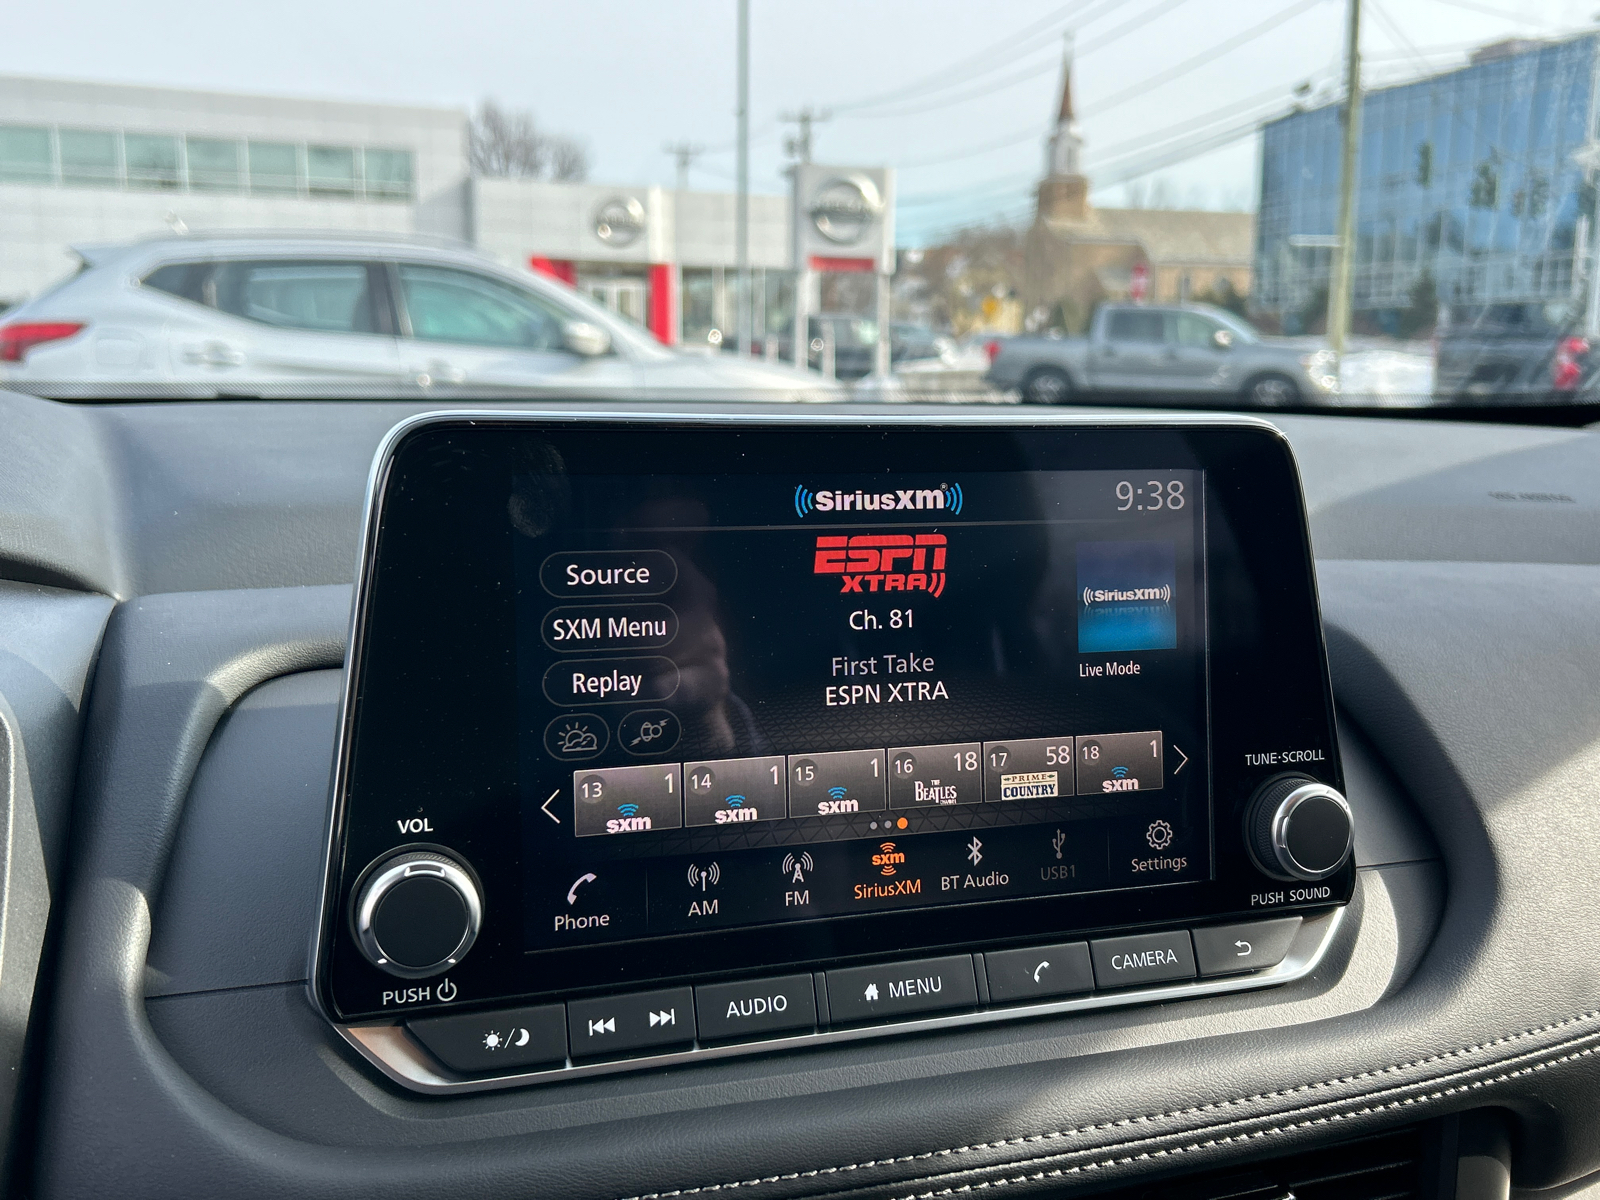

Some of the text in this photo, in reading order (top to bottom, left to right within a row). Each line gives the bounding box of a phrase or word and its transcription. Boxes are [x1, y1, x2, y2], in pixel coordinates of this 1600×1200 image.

[1115, 480, 1186, 511] 9:38
[813, 533, 948, 574] ESPN
[566, 564, 650, 586] Source
[840, 573, 928, 593] XTRA
[553, 617, 667, 640] SXM Menu
[849, 608, 914, 631] Ch. 81
[832, 652, 935, 677] First Take
[1079, 661, 1141, 678] Live Mode
[572, 669, 643, 698] Replay
[825, 680, 949, 706] ESPN XTRA
[1046, 745, 1071, 766] 58
[1082, 745, 1100, 760] 18
[1149, 739, 1158, 758] 1
[870, 758, 879, 778] 1
[894, 758, 914, 774] 16
[953, 751, 978, 772] 18
[990, 752, 1008, 767] 17
[664, 772, 674, 794] 1
[691, 773, 712, 790] 14
[769, 765, 779, 785] 1
[795, 765, 815, 782] 15
[1011, 773, 1047, 783] PRIME
[581, 782, 603, 799] 13
[1003, 783, 1056, 799] COUNTRY
[397, 817, 434, 834] VOL
[1040, 865, 1076, 881] USB1
[1131, 856, 1188, 872] Settings
[854, 878, 921, 900] SiriusXM
[941, 871, 1009, 891] BT Audio
[785, 889, 810, 907] FM
[1251, 886, 1331, 906] PUSH SOUND
[687, 899, 719, 917] AM
[554, 913, 610, 931] Phone
[1111, 948, 1178, 970] CAMERA
[382, 986, 431, 1005] PUSH
[888, 975, 942, 999] MENU
[726, 994, 788, 1018] AUDIO
